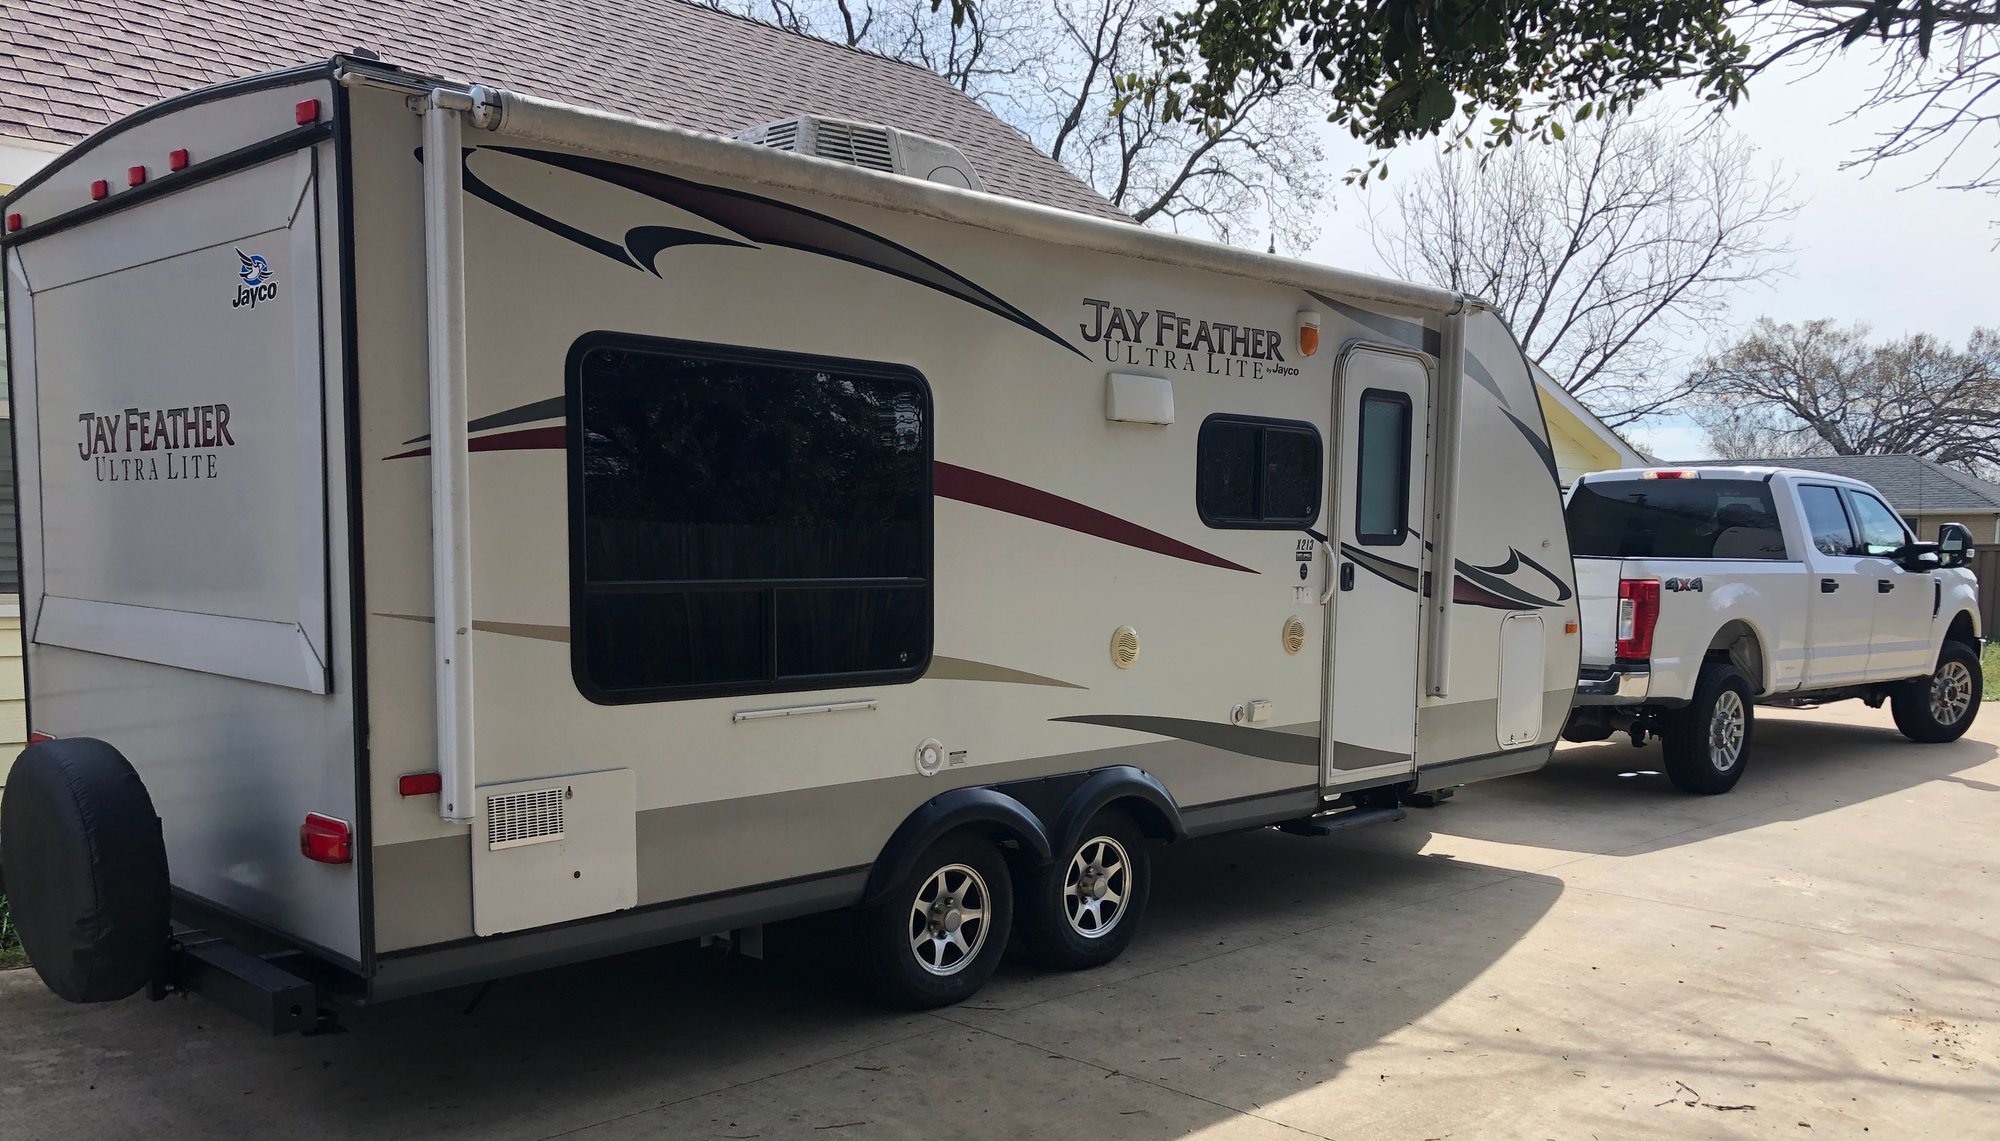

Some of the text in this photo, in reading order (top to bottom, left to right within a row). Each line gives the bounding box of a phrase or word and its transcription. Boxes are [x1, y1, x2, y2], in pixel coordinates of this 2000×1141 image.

[233, 282, 278, 309] Jayco
[1080, 298, 1285, 362] JAY FEATHER
[1104, 339, 1264, 380] ULTRA LITE
[1272, 363, 1300, 377] Jayco
[78, 403, 235, 461] JAY FEATHER
[95, 453, 218, 482] ULTRA LITE
[1296, 539, 1315, 551] X213
